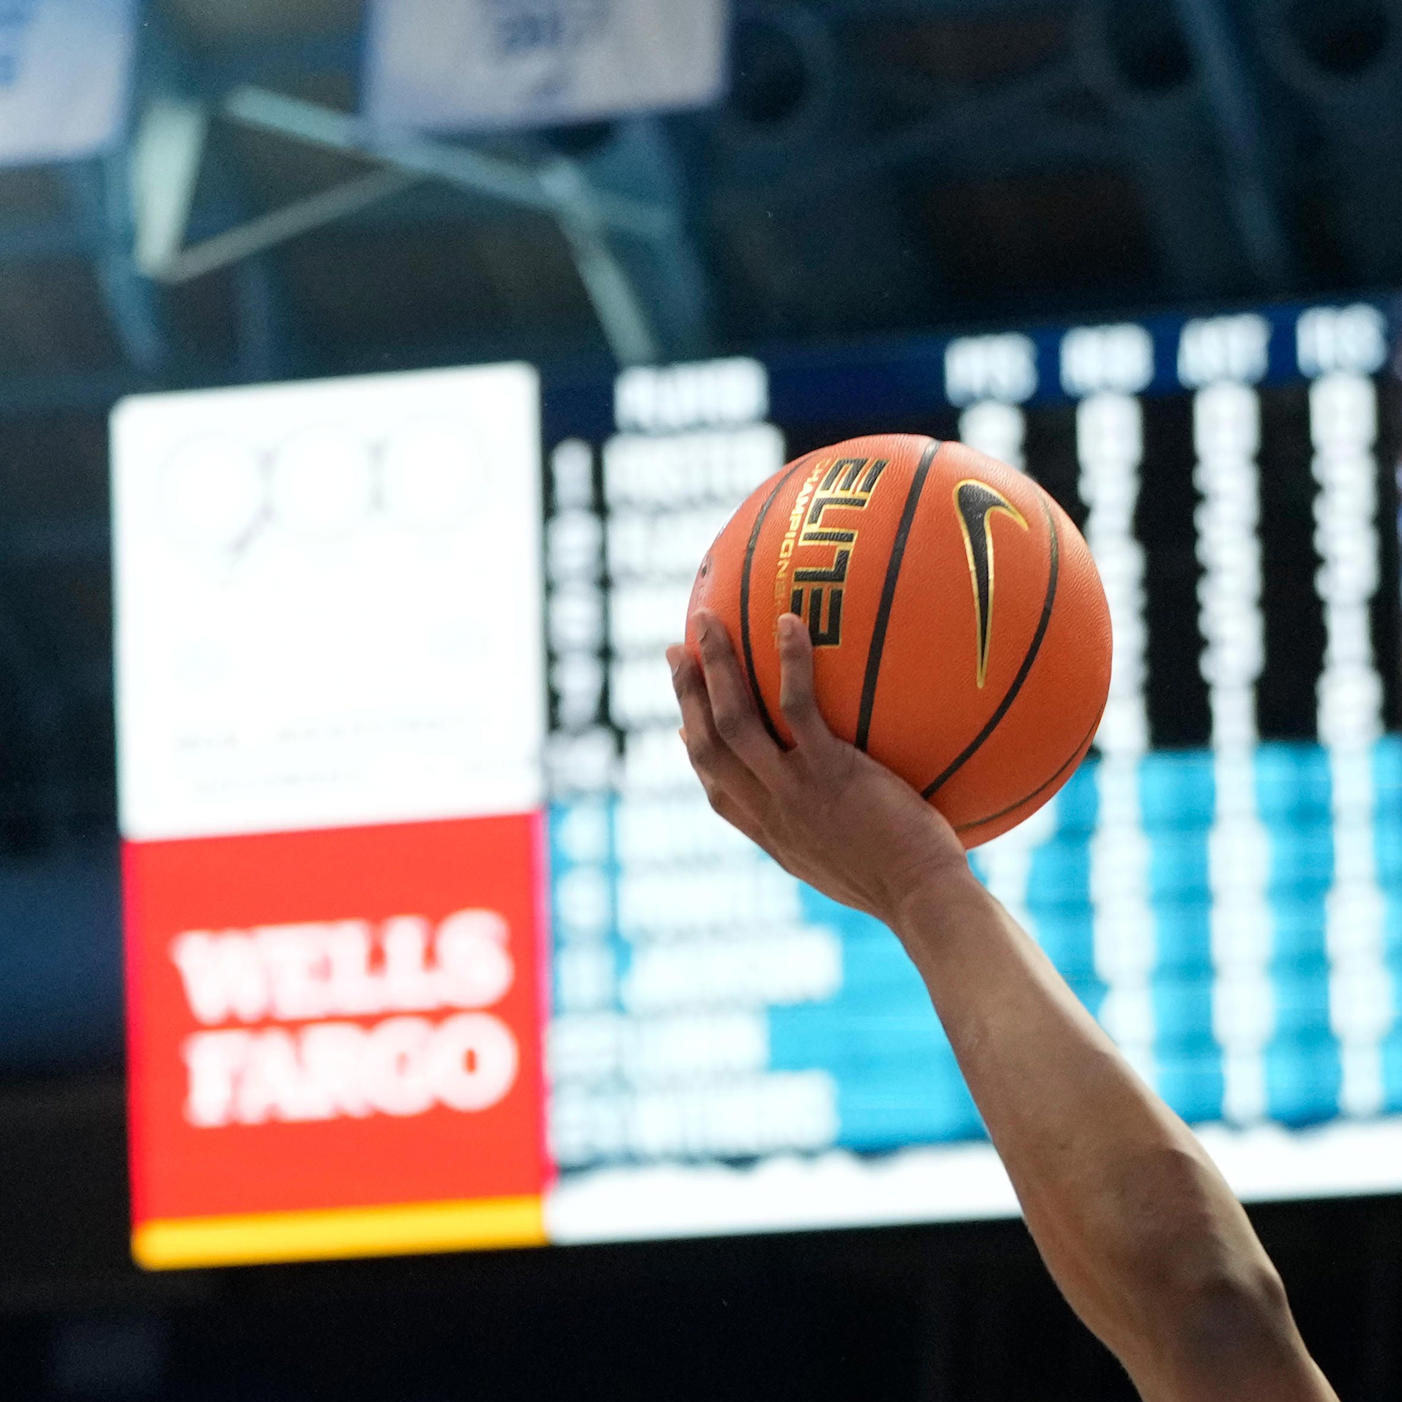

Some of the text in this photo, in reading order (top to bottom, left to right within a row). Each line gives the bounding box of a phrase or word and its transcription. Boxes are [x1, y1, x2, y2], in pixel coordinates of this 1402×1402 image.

[790, 458, 890, 649] ELITE
[170, 907, 513, 1025] WELLS
[183, 1011, 519, 1128] FARGO
